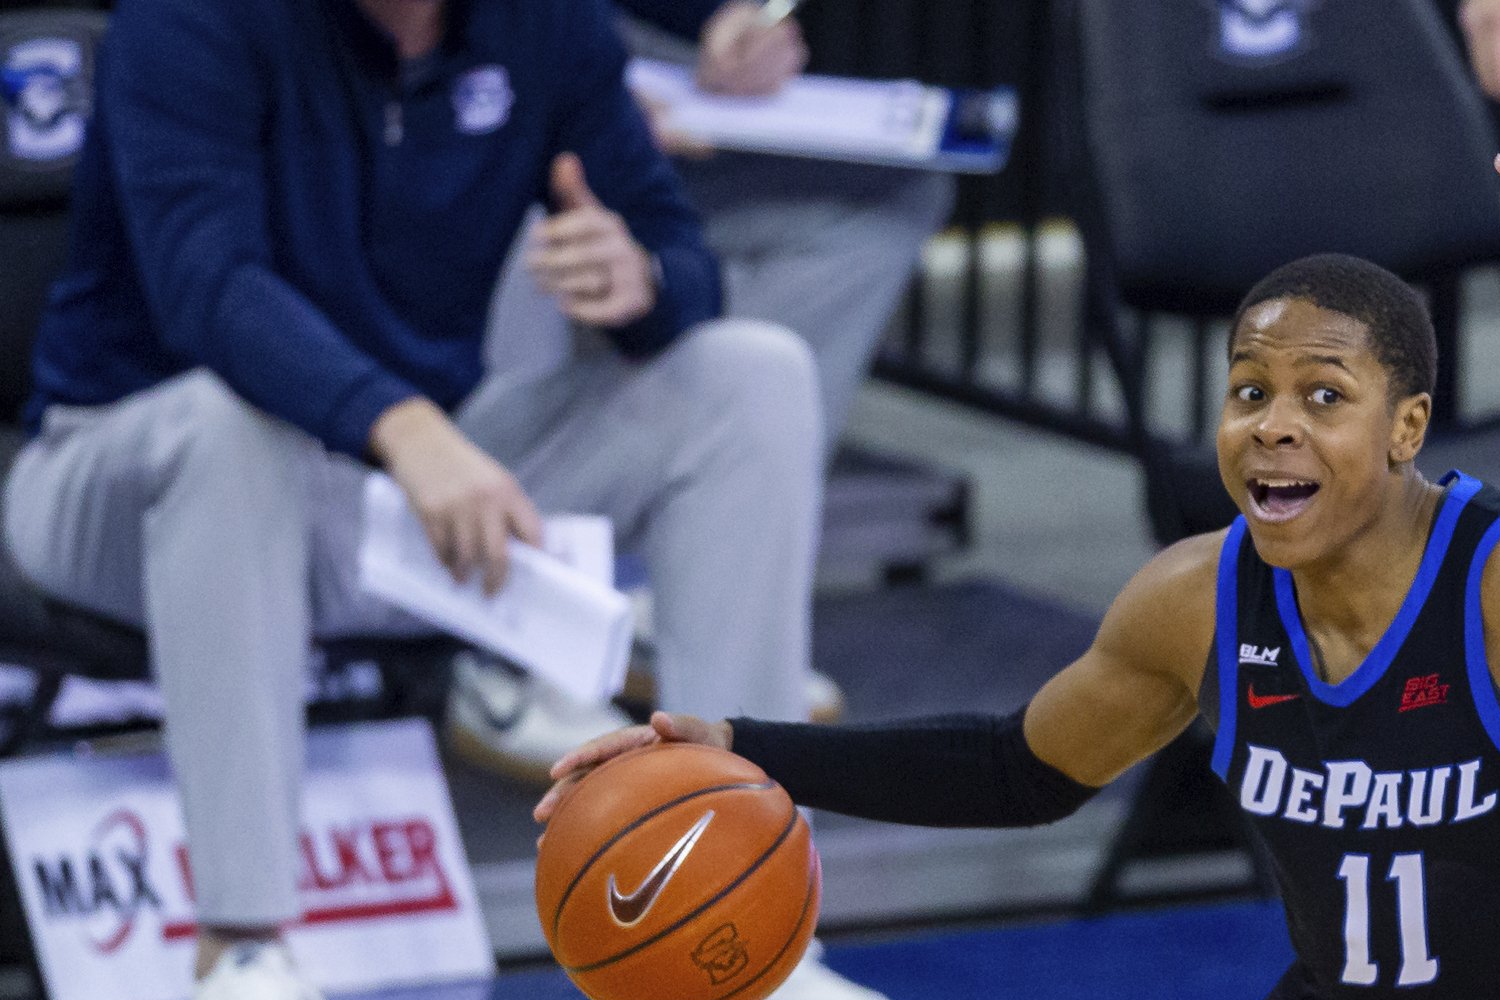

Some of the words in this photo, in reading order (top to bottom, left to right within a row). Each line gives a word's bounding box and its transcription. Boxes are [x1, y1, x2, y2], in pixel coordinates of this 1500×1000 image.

[1239, 643, 1281, 662] BLM
[1405, 673, 1440, 691] BIG
[1401, 684, 1450, 706] EAST
[33, 846, 164, 914] MAX
[172, 817, 454, 907] LKER
[1337, 852, 1439, 986] 11
